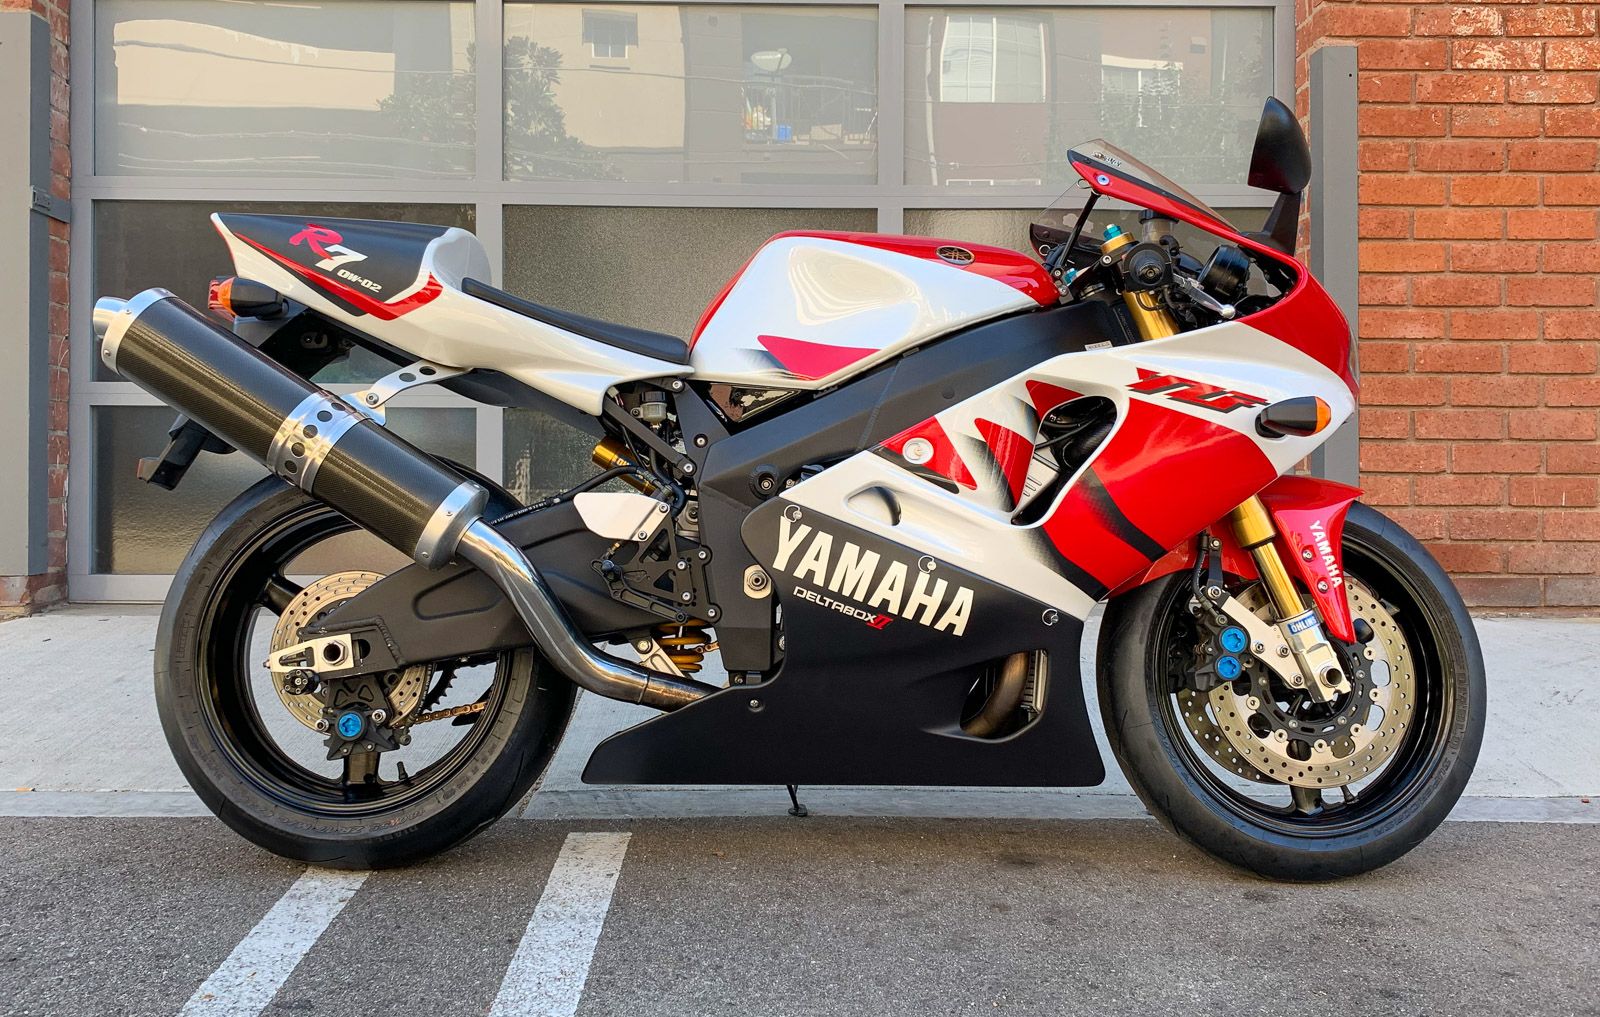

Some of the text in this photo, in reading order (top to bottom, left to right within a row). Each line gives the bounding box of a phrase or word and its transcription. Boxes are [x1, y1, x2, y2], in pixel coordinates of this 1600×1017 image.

[337, 268, 383, 293] OW-02
[1125, 367, 1271, 414] YZF
[772, 515, 975, 637] YAMAHA
[1309, 520, 1343, 589] YAMAHA
